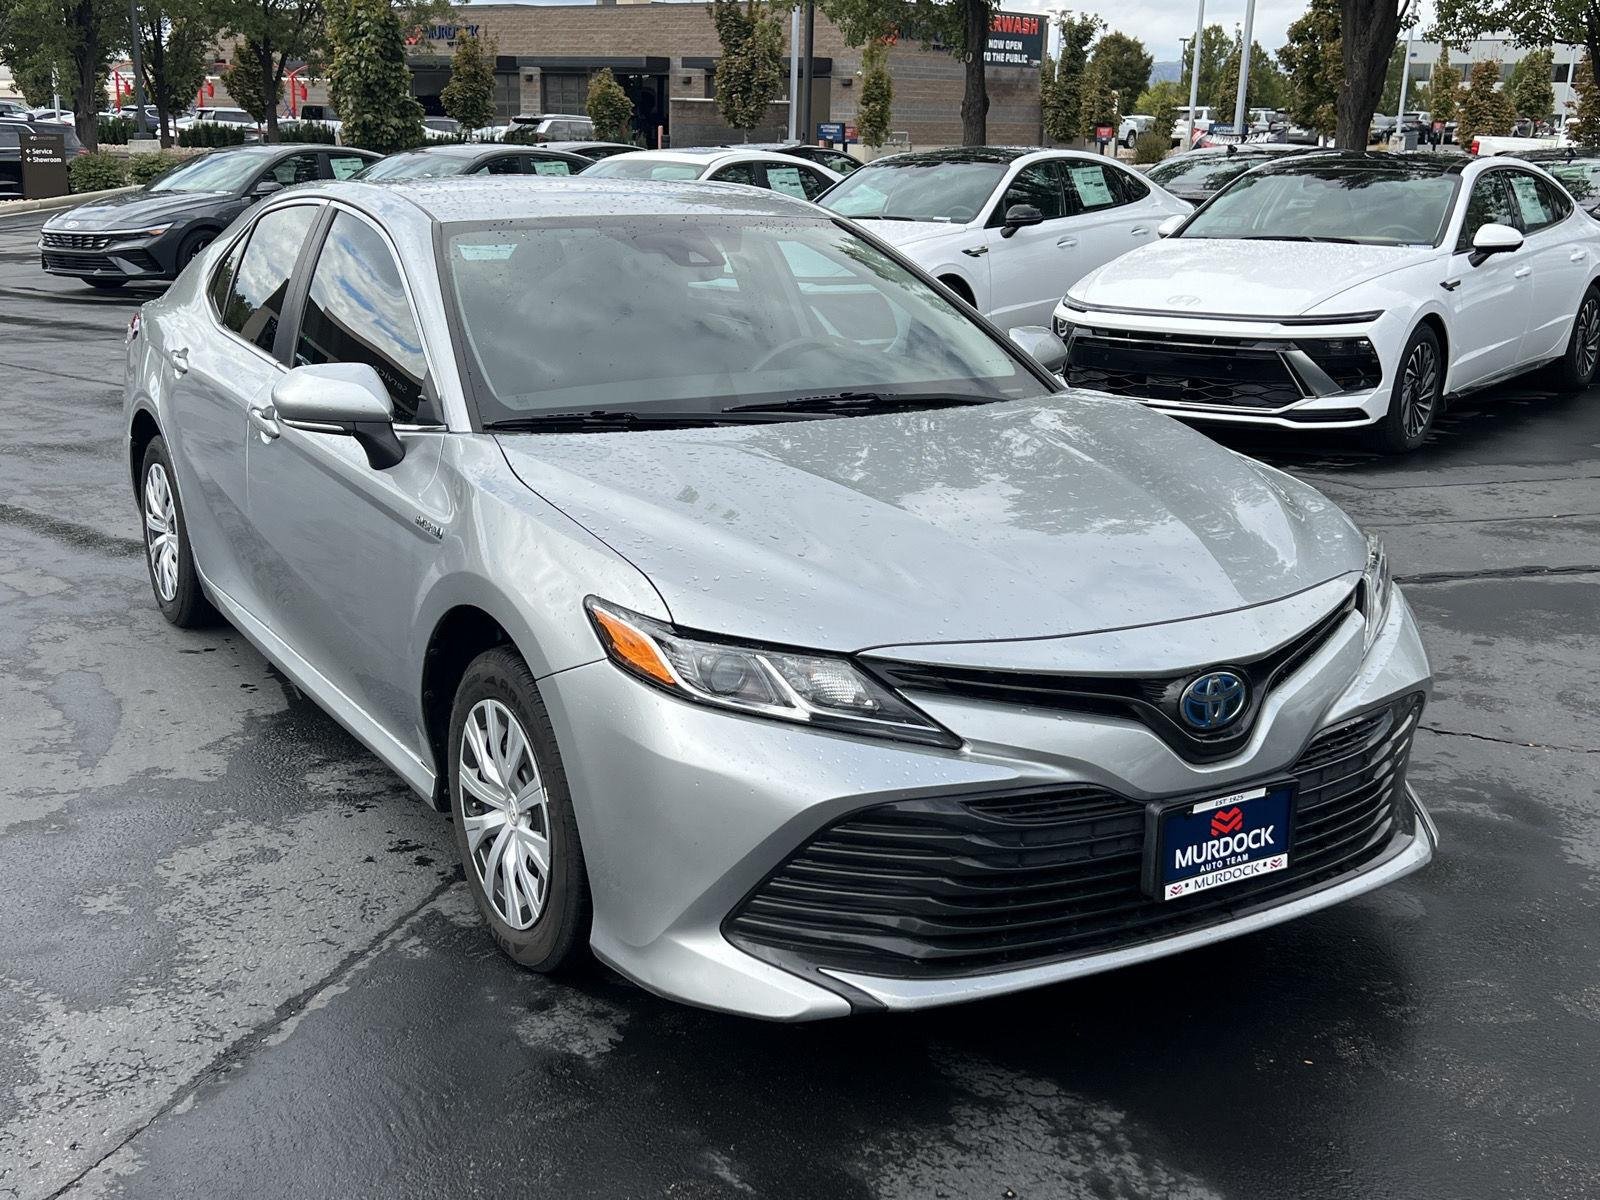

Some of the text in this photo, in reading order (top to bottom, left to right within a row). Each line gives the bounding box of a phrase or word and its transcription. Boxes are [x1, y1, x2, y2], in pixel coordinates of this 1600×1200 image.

[989, 15, 1038, 35] RWASH
[988, 39, 1022, 50] NOW OPEN
[992, 52, 1005, 62] THE
[1006, 53, 1028, 63] PUBLIC
[1175, 825, 1275, 869] MURDOCK
[1200, 853, 1249, 873] AUTO TEAM
[1194, 862, 1260, 890] MURDOCK
